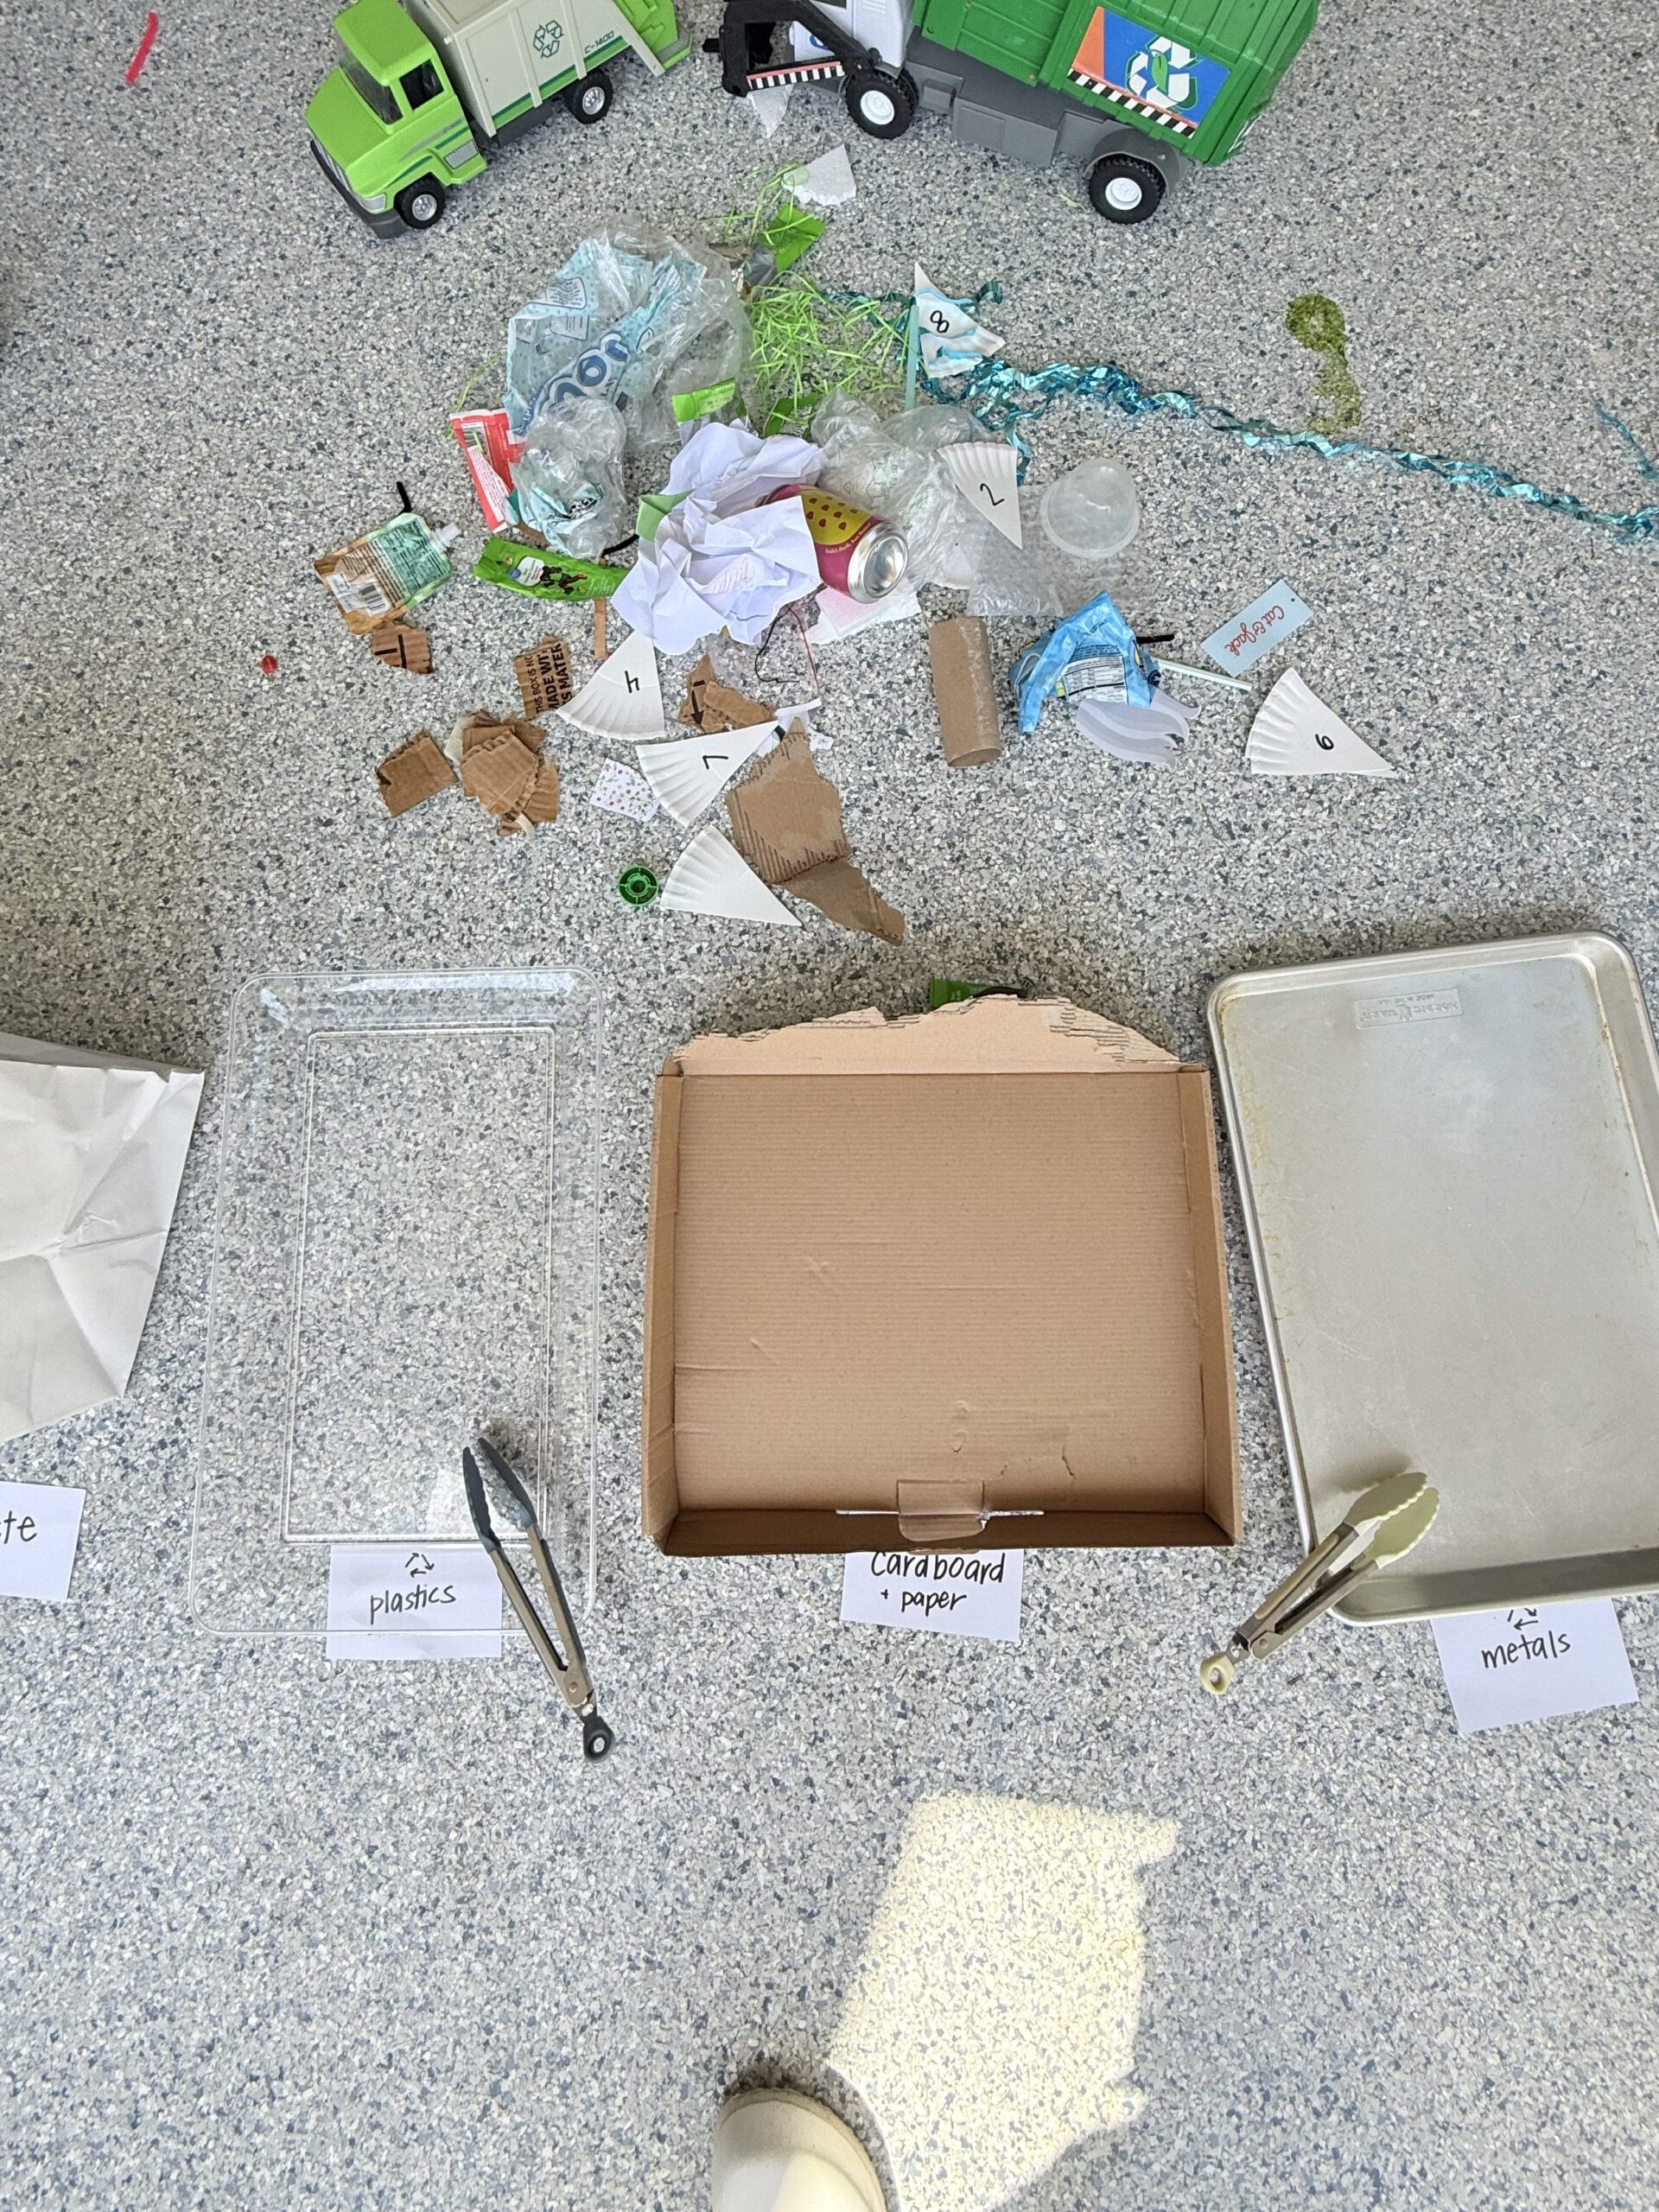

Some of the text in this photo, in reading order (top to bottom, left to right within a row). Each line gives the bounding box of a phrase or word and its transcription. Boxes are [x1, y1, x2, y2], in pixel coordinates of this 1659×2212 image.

[930, 310, 950, 333] 8
[980, 483, 1005, 505] 2
[1224, 606, 1284, 656] Cat & Jack
[530, 677, 541, 695] BOX
[534, 696, 543, 714] THIS
[0, 1510, 37, 1544] te
[871, 1552, 1006, 1584] Cardboard
[370, 1584, 456, 1625] plastics
[901, 1591, 967, 1616] paper
[1481, 1630, 1571, 1669] metals
